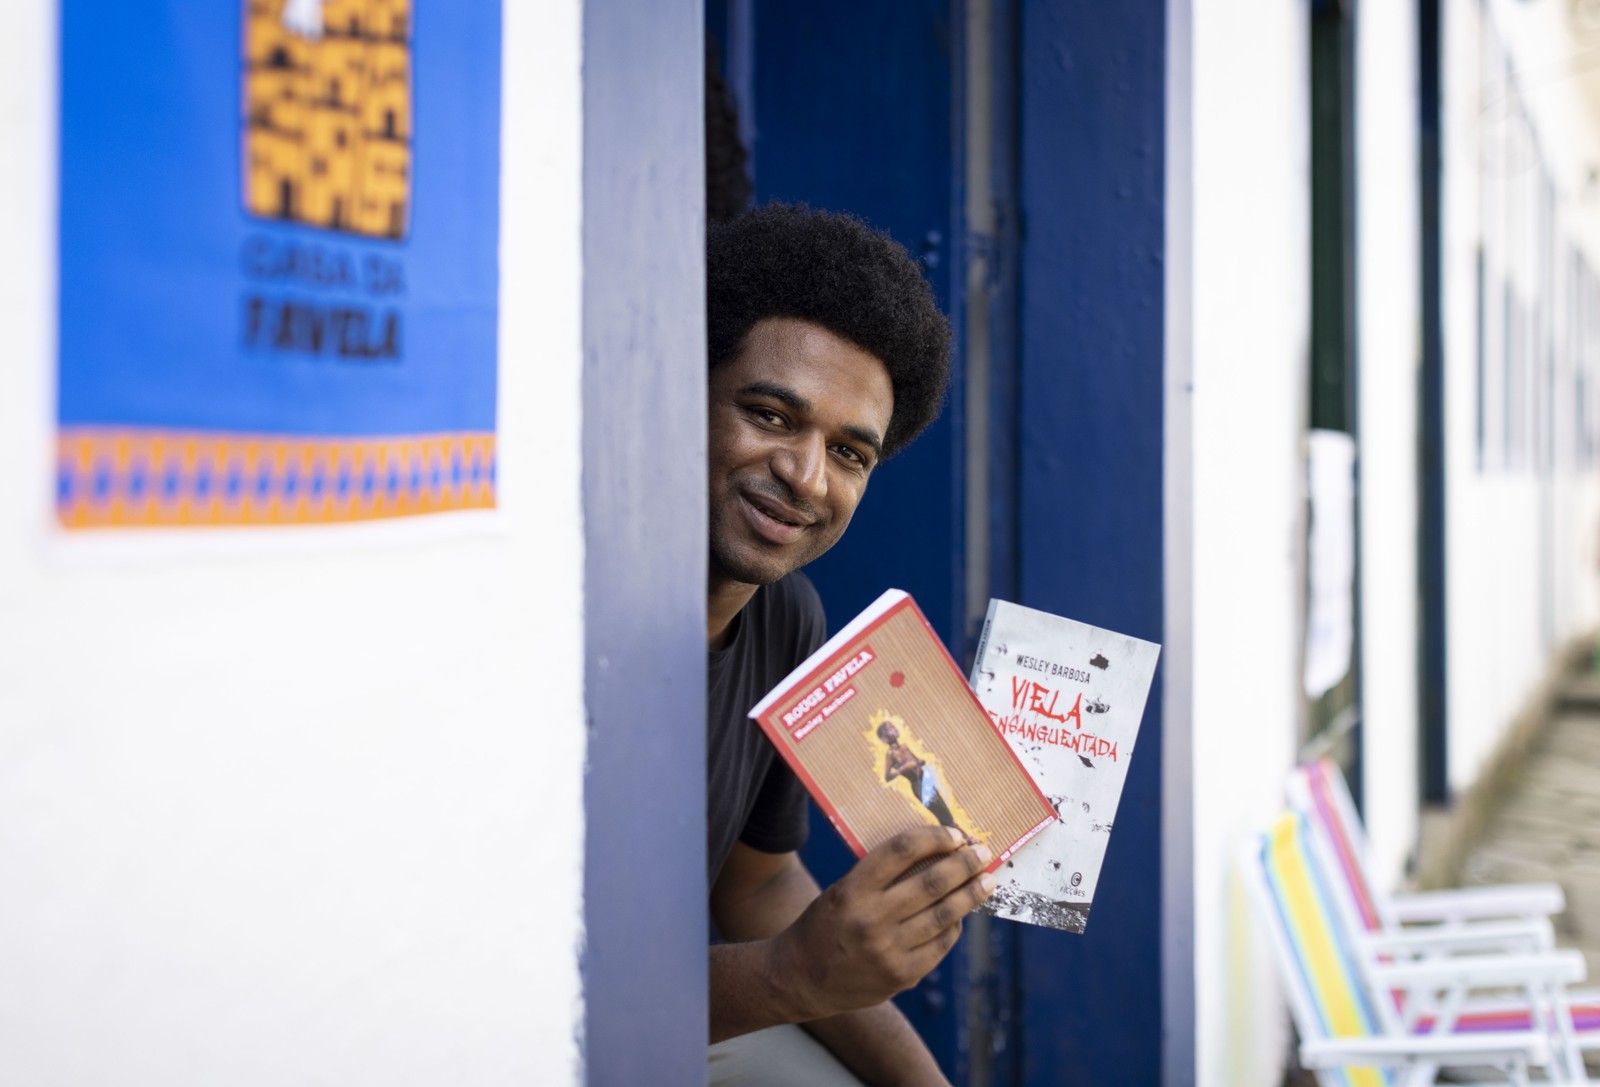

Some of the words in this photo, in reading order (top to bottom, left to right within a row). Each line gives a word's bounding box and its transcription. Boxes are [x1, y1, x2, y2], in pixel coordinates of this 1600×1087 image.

[245, 294, 401, 360] FAVELA
[783, 687, 826, 727] ROUGE
[823, 651, 873, 693] FAVELA
[1016, 654, 1050, 673] WESLEY
[1051, 663, 1091, 684] BARBOSA
[794, 713, 823, 740] Wesley
[822, 688, 856, 717] Barbosa
[1012, 675, 1082, 730] VIELA
